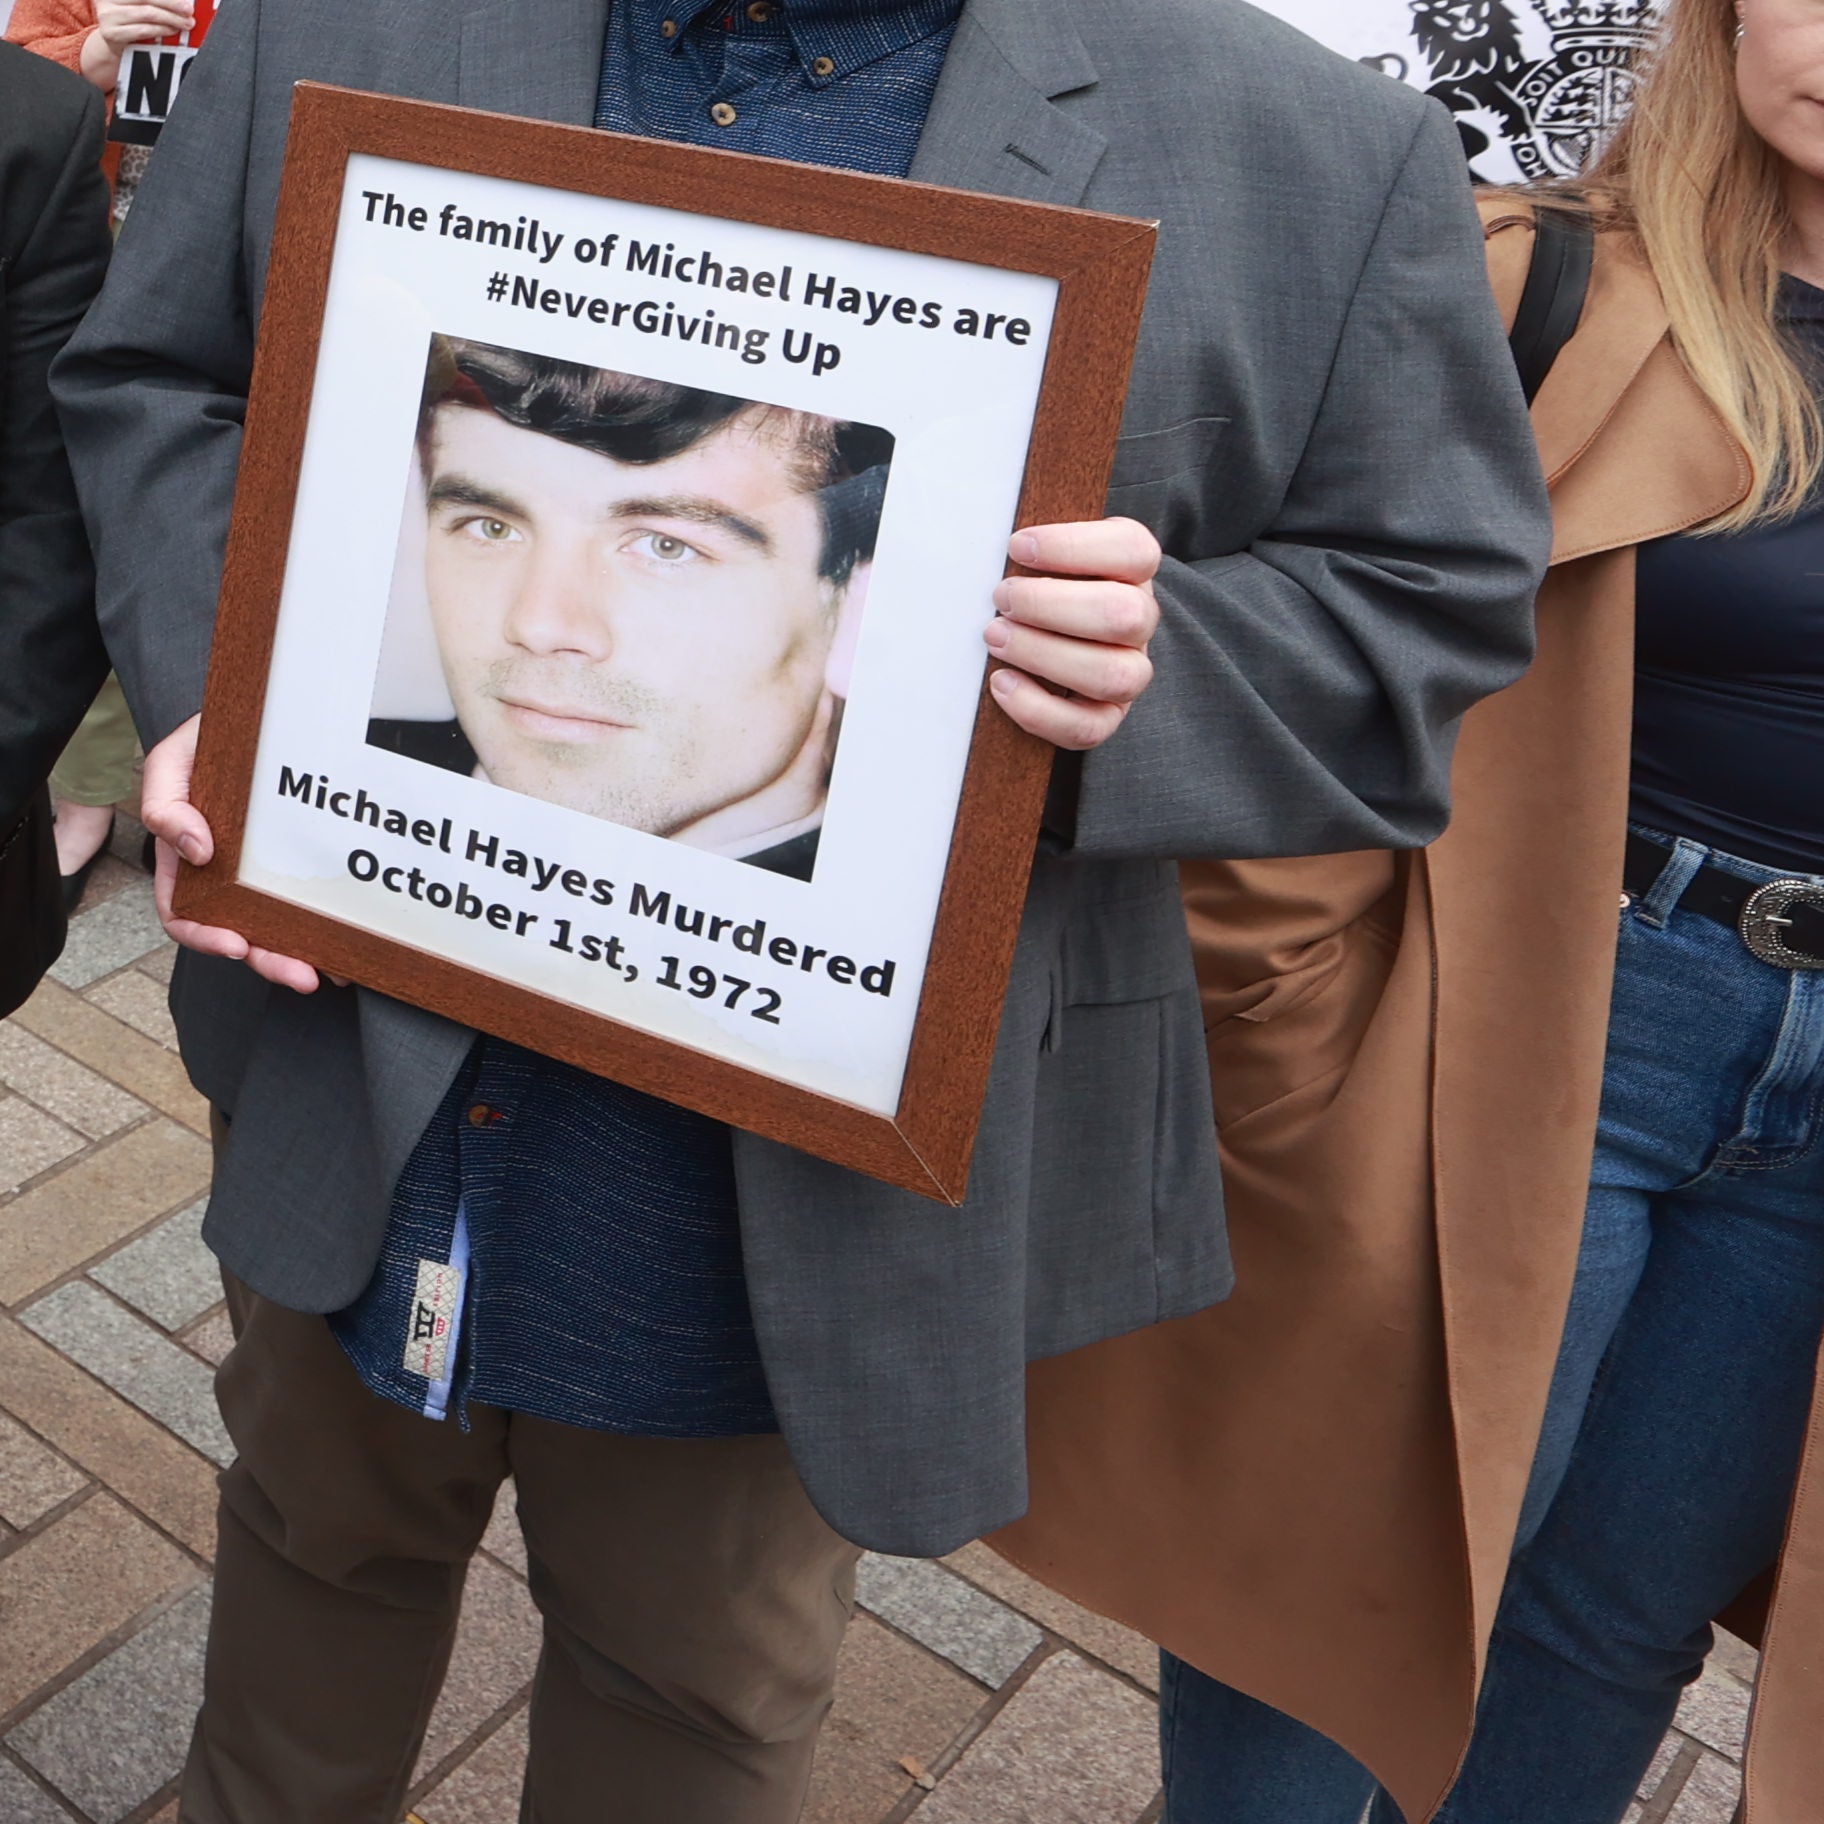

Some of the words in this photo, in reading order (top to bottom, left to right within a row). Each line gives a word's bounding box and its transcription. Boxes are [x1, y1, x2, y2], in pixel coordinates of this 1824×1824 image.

[361, 190, 428, 233] The
[439, 203, 564, 264] family
[574, 233, 618, 266] of
[628, 240, 790, 303] Michael
[806, 272, 942, 330] Hayes
[953, 308, 1032, 346] are
[486, 270, 769, 365] #NeverGiving
[782, 329, 842, 376] Up
[277, 765, 453, 853] Michael
[466, 828, 614, 906] Hayes
[629, 882, 896, 997] Murdered
[346, 848, 538, 936] October
[550, 918, 640, 983] 1st,
[657, 955, 783, 1025] 1972
